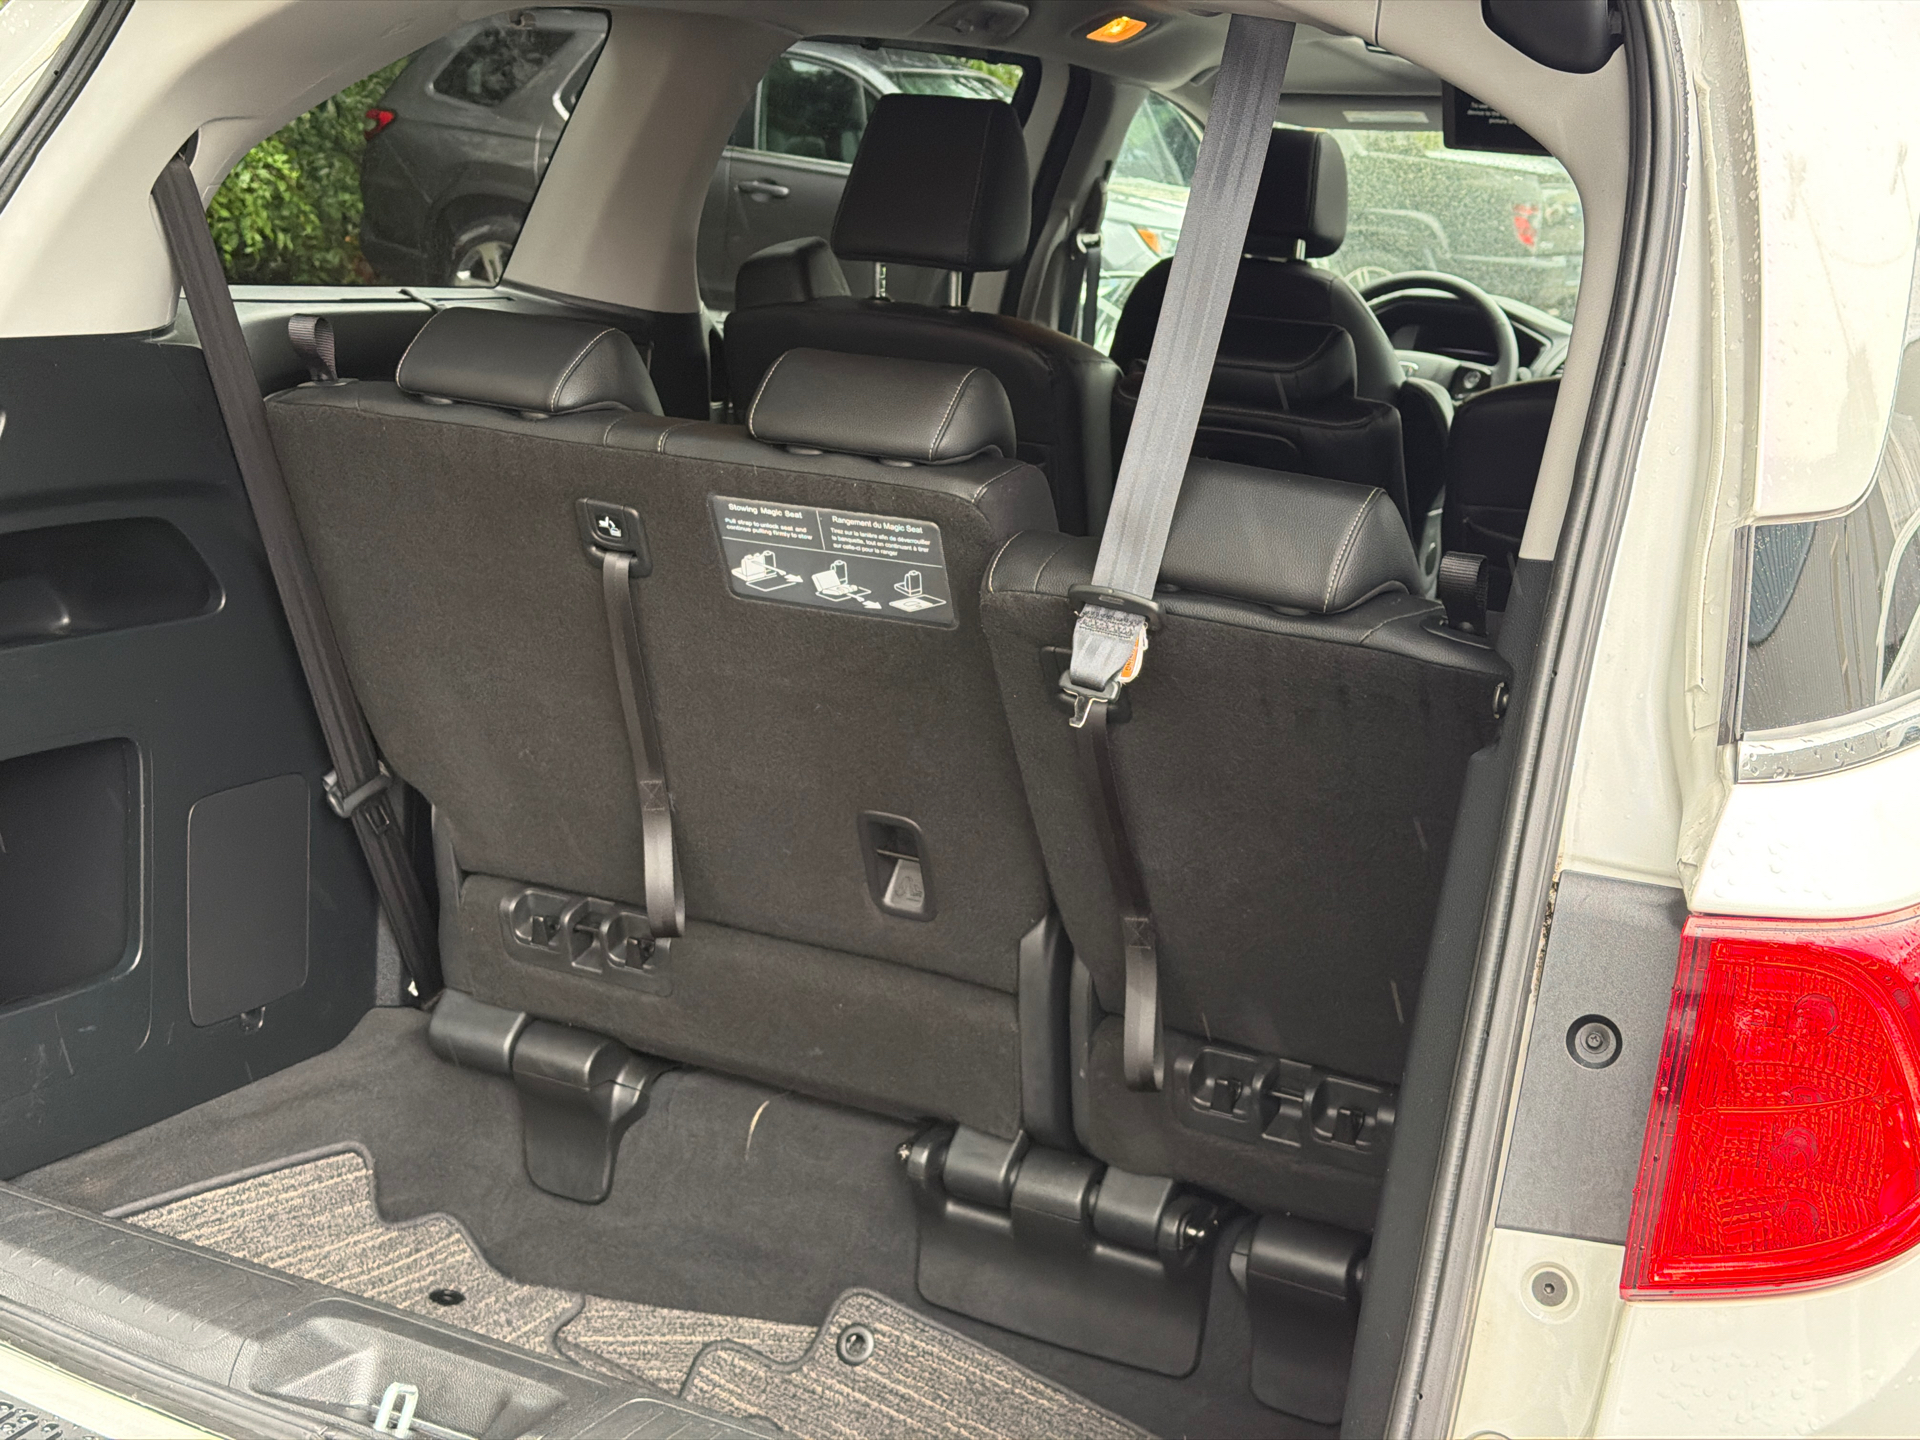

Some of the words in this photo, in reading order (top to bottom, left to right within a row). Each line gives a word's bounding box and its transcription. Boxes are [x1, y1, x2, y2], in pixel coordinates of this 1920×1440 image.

[728, 503, 758, 515] Stowing
[760, 507, 782, 517] Magic
[784, 510, 803, 519] Seat
[737, 518, 752, 527] strap
[832, 515, 872, 527] Rangement
[883, 522, 905, 532] Magic
[906, 525, 923, 534] Seat
[726, 524, 751, 532] continue
[752, 528, 772, 536] pulling
[773, 530, 791, 538] firmly
[885, 542, 912, 551] continuant
